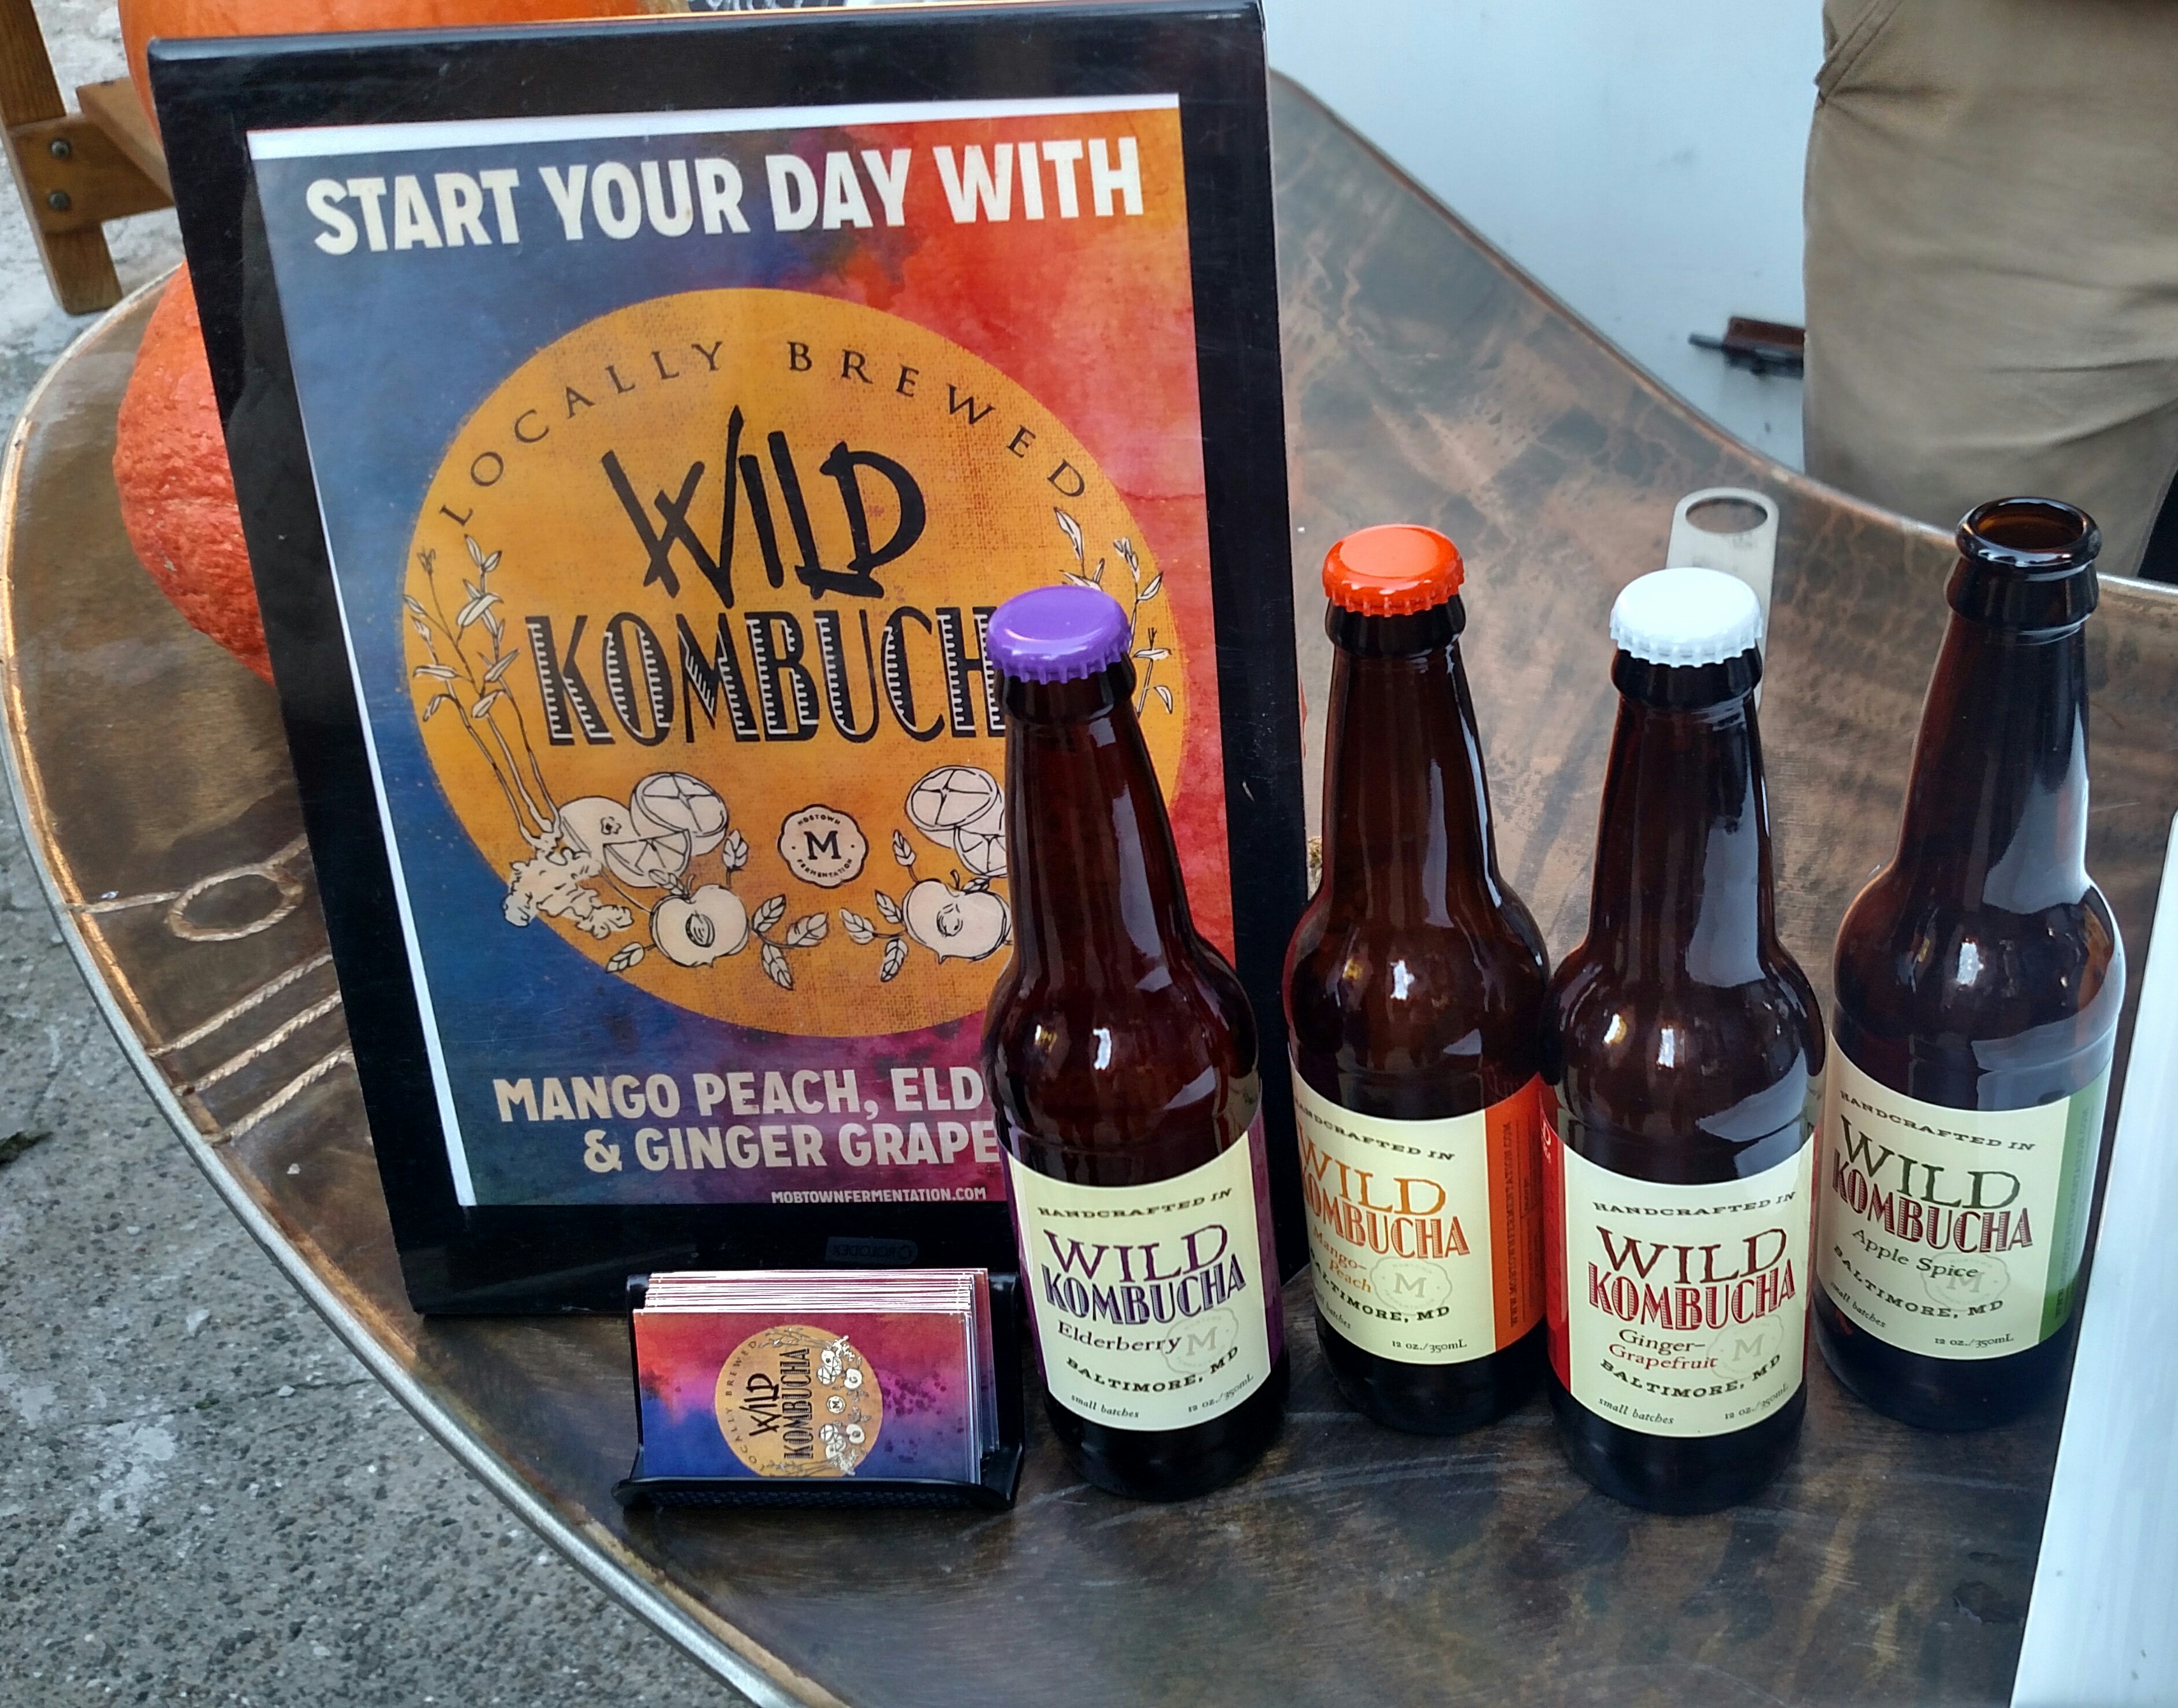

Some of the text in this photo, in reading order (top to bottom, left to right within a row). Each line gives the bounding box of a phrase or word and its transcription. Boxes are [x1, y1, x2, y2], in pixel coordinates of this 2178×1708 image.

[304, 135, 1144, 255] START YOUR DAY WITH
[440, 340, 1087, 527] LOCALLY BREWED
[601, 405, 926, 609] WILD
[525, 605, 1006, 748] KOMBUCH
[796, 858, 853, 878] FERMENTATION
[803, 830, 842, 860] M
[492, 1066, 984, 1122] MANGO PEACH, ELD
[1840, 1090, 2002, 1147] HANDCRAFTED
[583, 1120, 1000, 1172] & GINGER GRAPE
[1297, 1121, 1446, 1216] WILD
[1427, 1150, 1455, 1161] IN
[1841, 1114, 2021, 1209] WILD
[771, 1187, 987, 1204] MOBTOWNFERMENTATION.COM
[1038, 1188, 1232, 1218] HANDCRAFTED IN
[1301, 1166, 1470, 1259] OMBUCHA
[1592, 1191, 1796, 1216] HANDCRAFTED IN
[1833, 1148, 2033, 1253] KOMBUCHA
[1043, 1224, 1228, 1283] WILD
[1329, 1259, 1371, 1293] Peach
[1596, 1225, 1787, 1284] WILD
[1852, 1230, 1979, 1279] Apple Spice
[1041, 1253, 1246, 1325] KOMBUCHA
[1588, 1258, 1796, 1331] KOMBUCHA
[1834, 1245, 1958, 1319] BALTIMORE,
[1967, 1300, 2004, 1316] MD
[1058, 1319, 1182, 1354] Elderberry
[1417, 1306, 1450, 1321] MD
[1852, 1302, 1886, 1328] batches
[725, 1340, 757, 1396] BREWED
[1066, 1356, 1204, 1393] BALTIMORE,
[1209, 1346, 1238, 1374] MD
[1600, 1359, 1745, 1398] BALTIMORE,
[1752, 1354, 1781, 1382] MD
[1609, 1343, 1719, 1370] Grapefruit
[739, 1373, 782, 1436] WILD
[779, 1348, 814, 1459] KOMBUCHA
[1070, 1394, 1139, 1418] small batches
[1598, 1397, 1675, 1425] small batches
